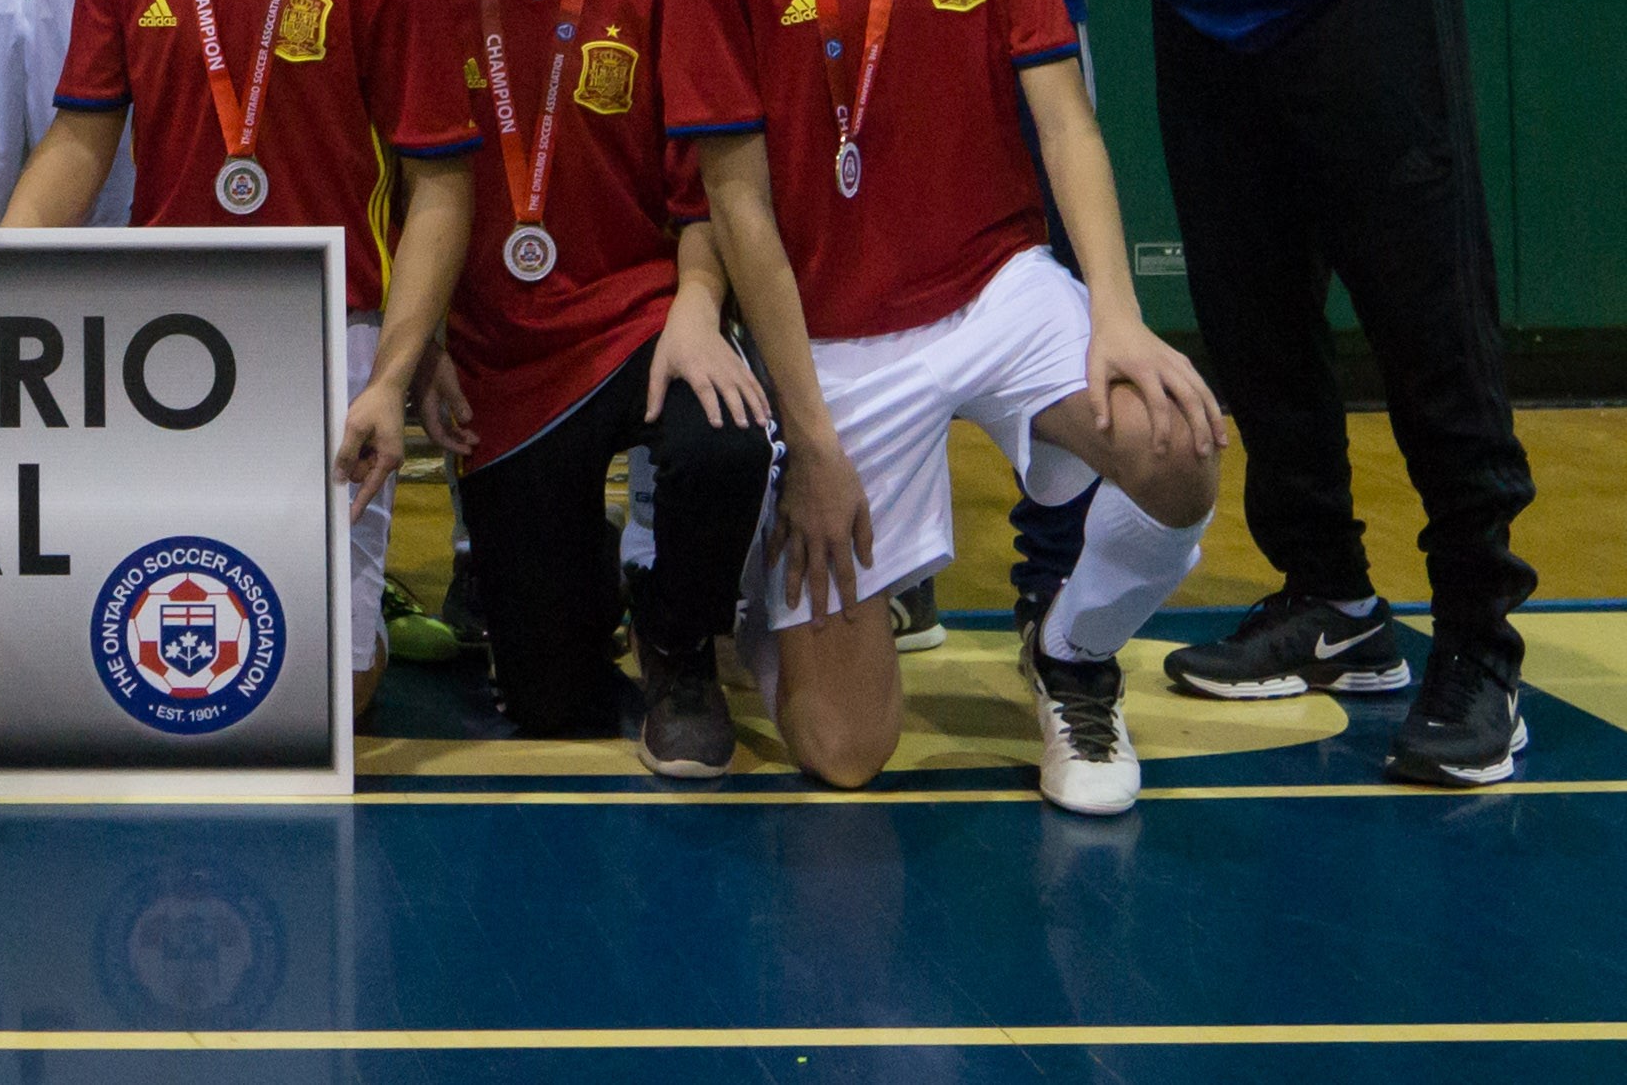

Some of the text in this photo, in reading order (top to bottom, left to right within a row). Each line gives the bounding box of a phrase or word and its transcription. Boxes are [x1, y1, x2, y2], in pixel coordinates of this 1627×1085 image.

[138, 16, 177, 27] adidas
[781, 7, 819, 25] adid
[254, 49, 268, 85] SOCCER
[486, 34, 516, 135] CHAMPION
[245, 86, 260, 126] ONTARIO
[241, 128, 252, 145] THE
[528, 53, 564, 211] THE ONTARIO SOCCER ASSOCIATION
[102, 548, 275, 699] THE ONTARIO SOCCER ASSOCIATION
[156, 705, 220, 722] EST. 1901
